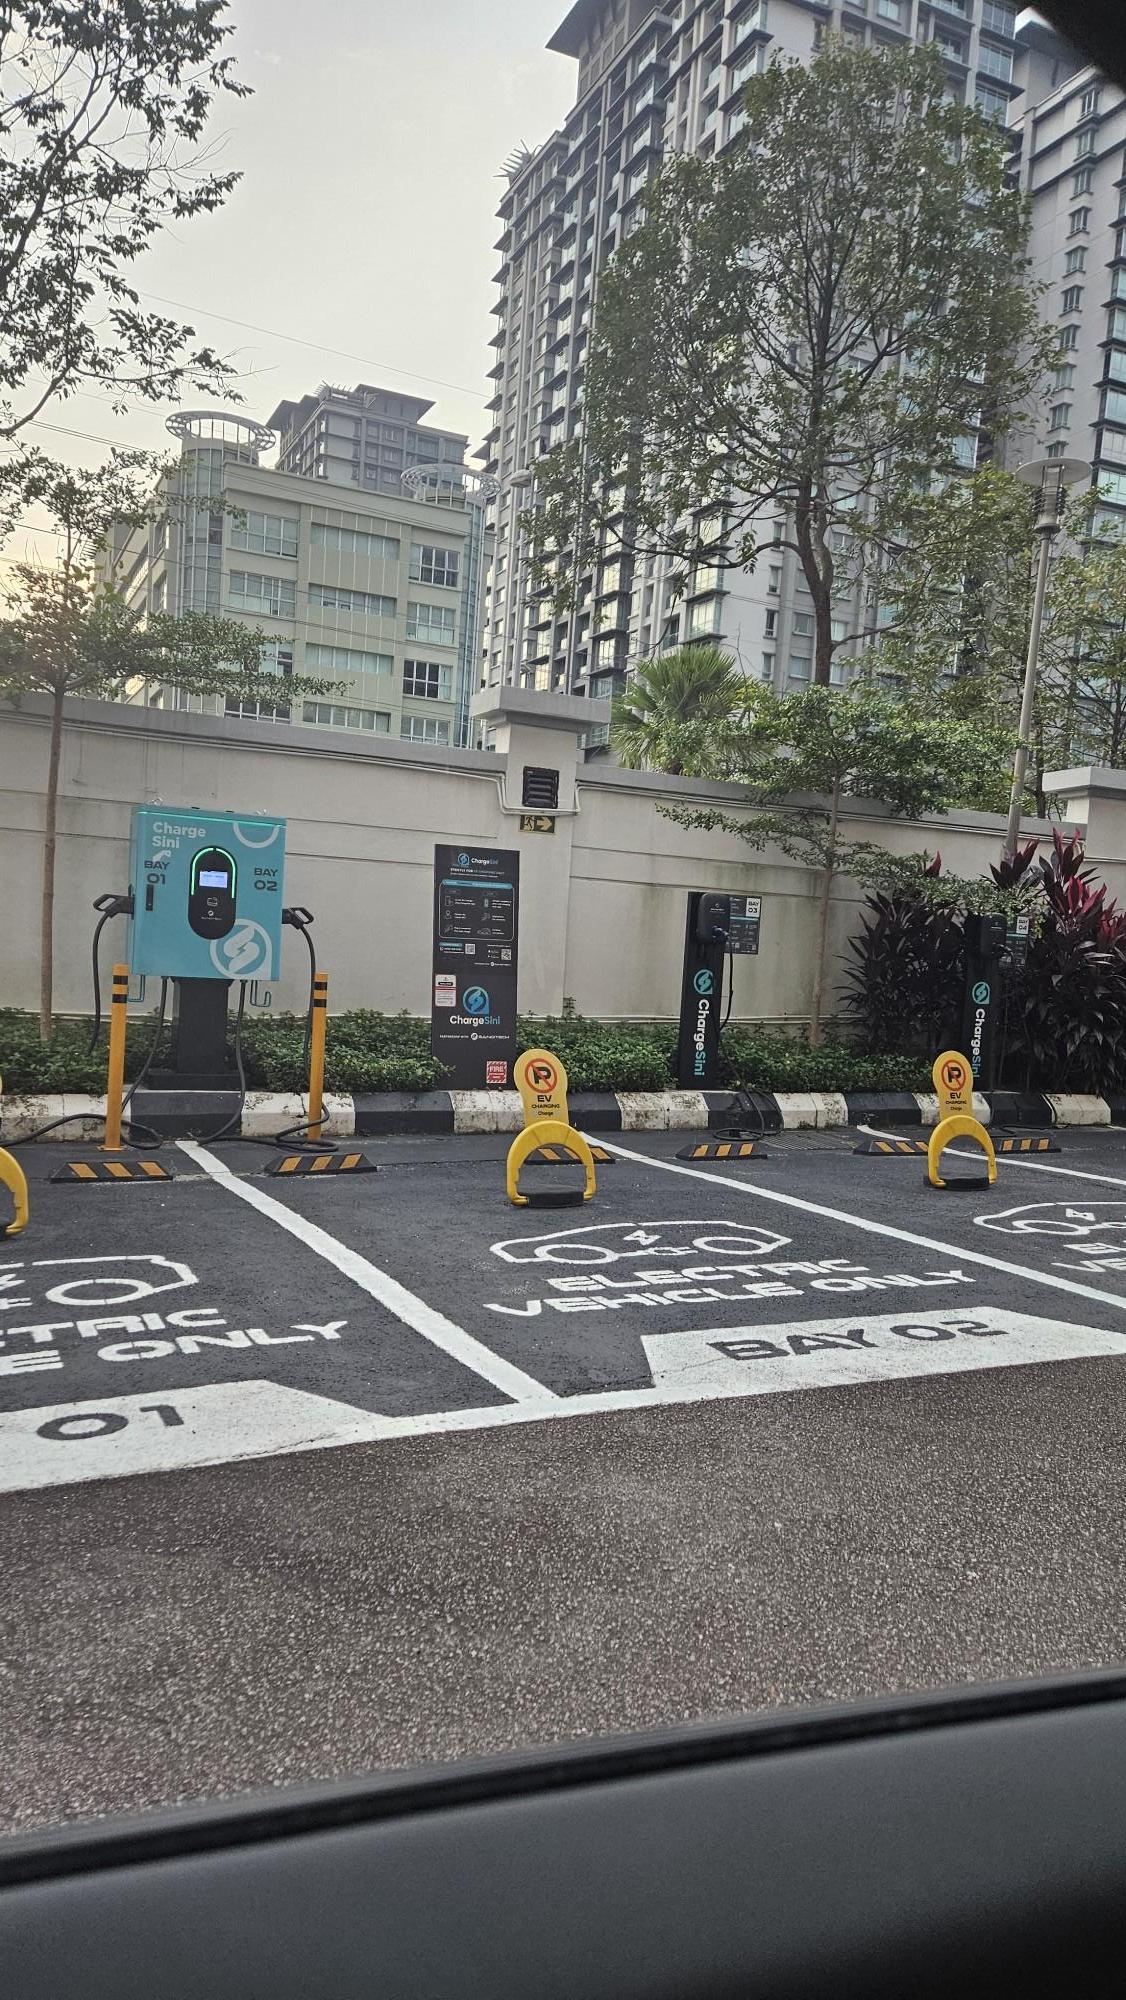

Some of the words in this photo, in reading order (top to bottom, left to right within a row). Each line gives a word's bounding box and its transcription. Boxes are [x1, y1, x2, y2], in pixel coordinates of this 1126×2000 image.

[152, 821, 206, 839] Charge
[152, 835, 180, 849] Sini
[144, 859, 170, 870] BAY
[253, 867, 279, 877] BAY
[147, 872, 166, 885] 01
[253, 879, 278, 892] 02
[449, 1015, 501, 1027] ChargeSini
[693, 999, 710, 1076] ChargeSini
[537, 1094, 552, 1103] EV
[1063, 1241, 1126, 1254] EL
[1050, 1258, 1126, 1273] VE
[546, 1259, 870, 1292] ELECTRIC
[483, 1281, 805, 1317] VEHICLE
[810, 1269, 977, 1293] ONLY
[0, 1308, 227, 1348] TRIC
[97, 1321, 348, 1361] ONLY
[706, 1328, 879, 1361] BAY
[889, 1320, 1010, 1343] 02
[36, 1404, 185, 1441] 01
